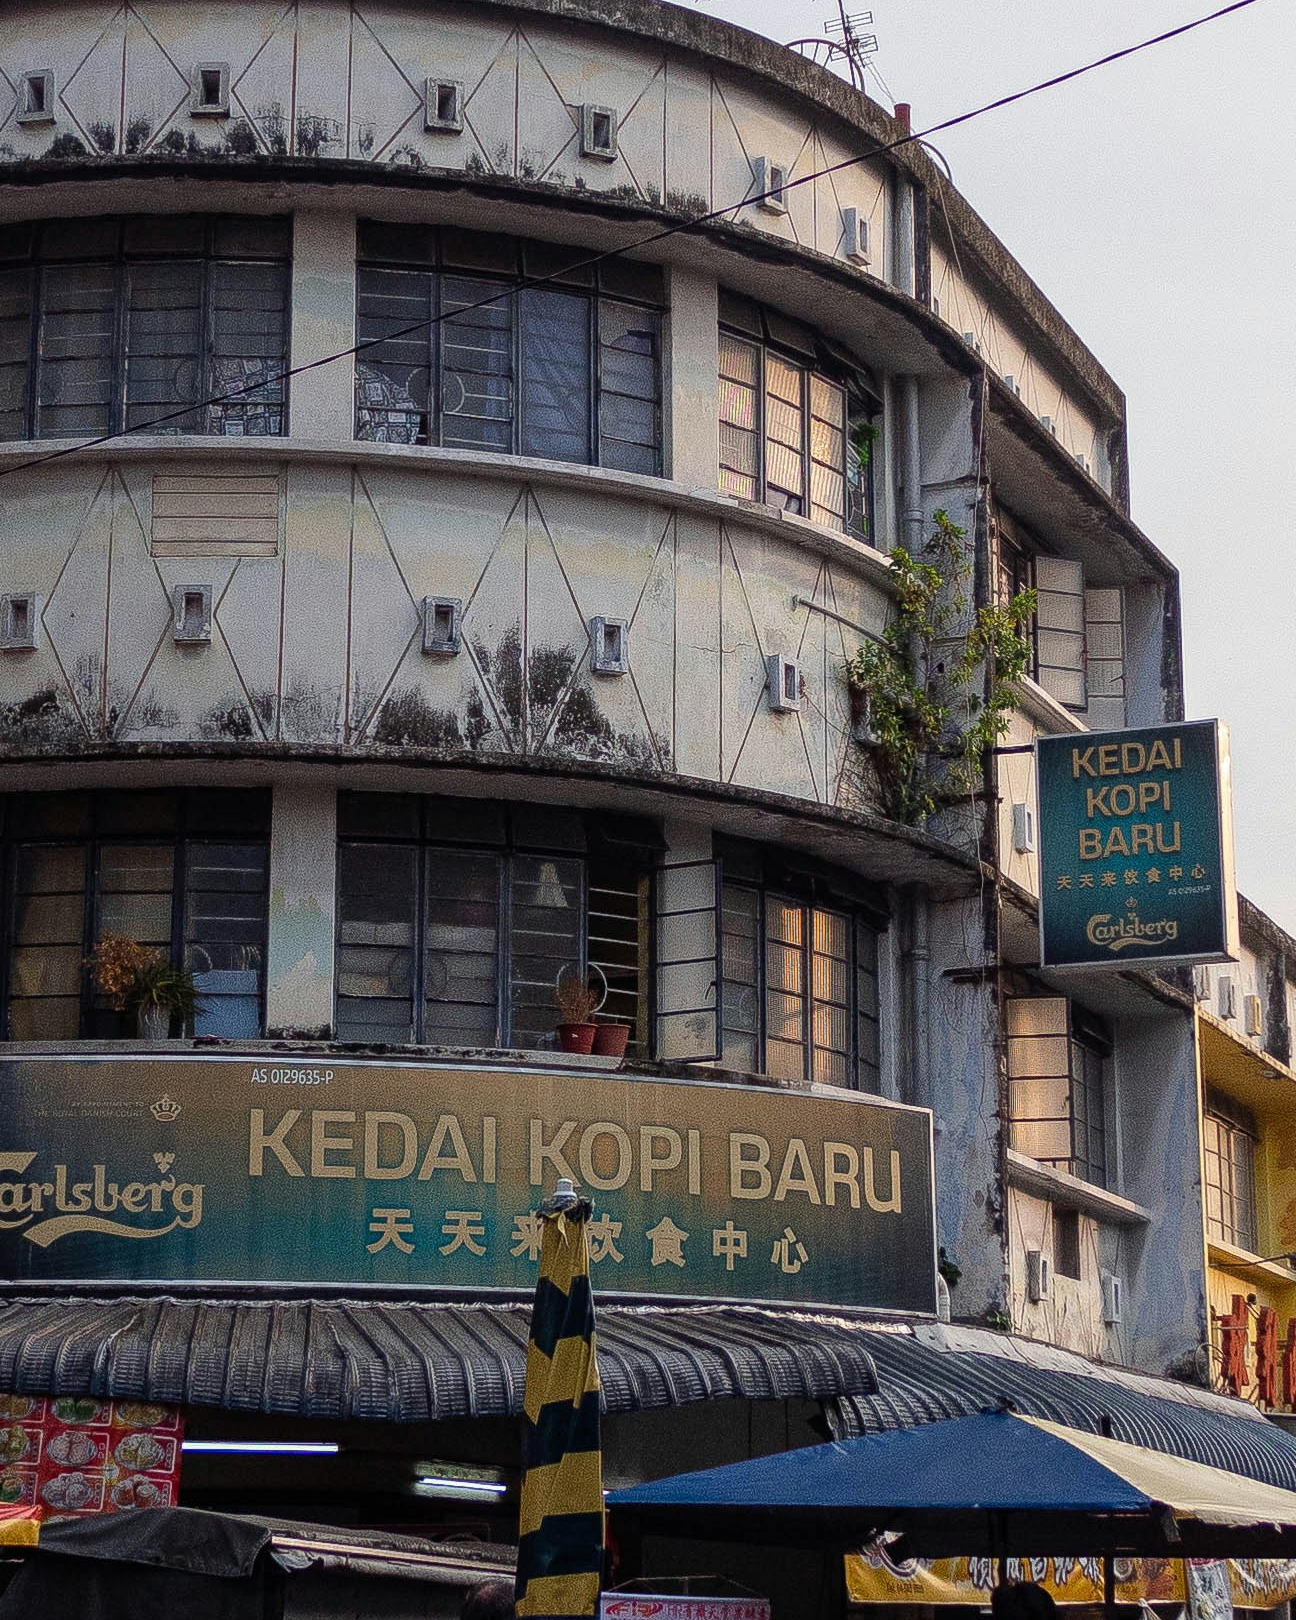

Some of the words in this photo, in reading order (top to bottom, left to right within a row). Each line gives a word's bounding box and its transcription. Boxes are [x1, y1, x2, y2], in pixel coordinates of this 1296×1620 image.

[1072, 738, 1184, 778] KEDAI
[1086, 780, 1170, 818] KOPI
[1079, 821, 1181, 860] BARU
[1086, 913, 1179, 948] Carlsberg
[251, 1068, 267, 1084] AS
[271, 1069, 334, 1085] 0129635-P
[250, 1107, 496, 1184] KEDAI
[531, 1118, 701, 1196] KOPI
[730, 1133, 903, 1214] BARU
